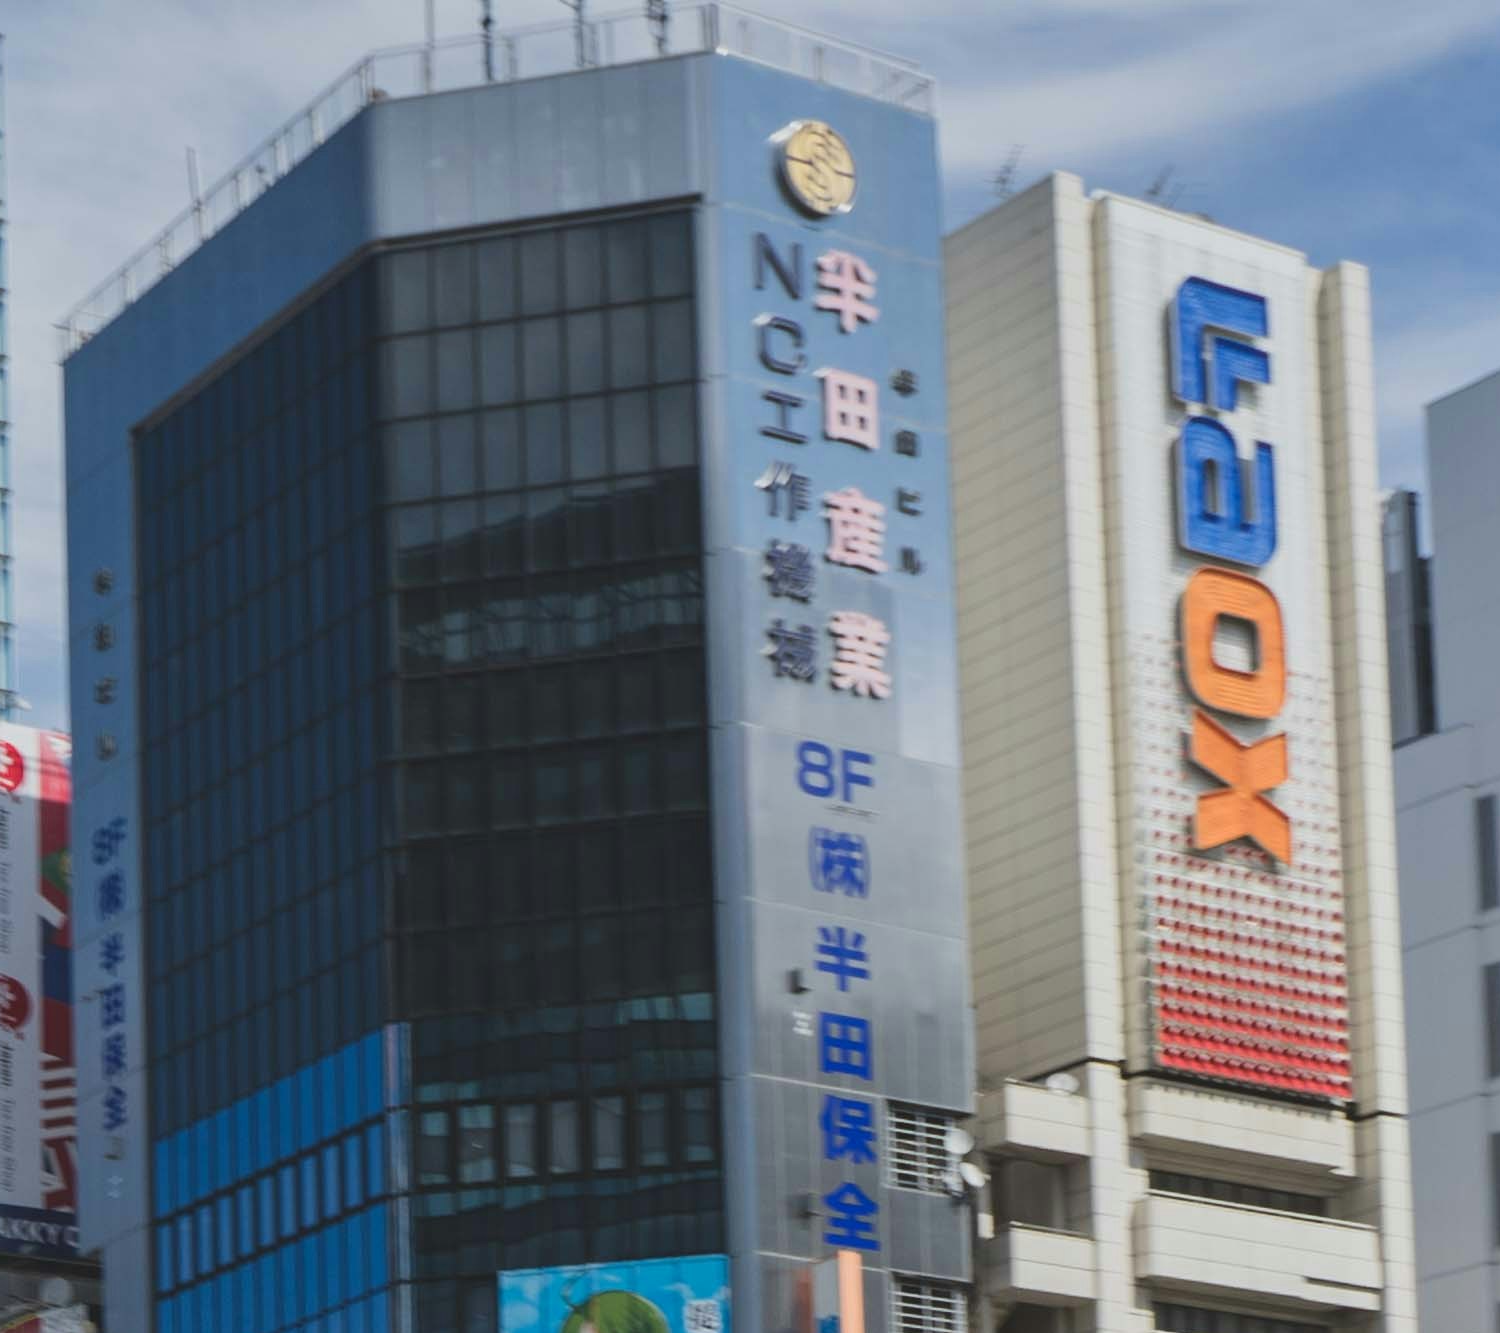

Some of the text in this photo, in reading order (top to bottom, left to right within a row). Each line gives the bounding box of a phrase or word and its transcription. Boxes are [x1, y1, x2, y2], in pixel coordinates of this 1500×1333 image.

[814, 249, 892, 702] 半田産業
[796, 741, 876, 804] 8F
